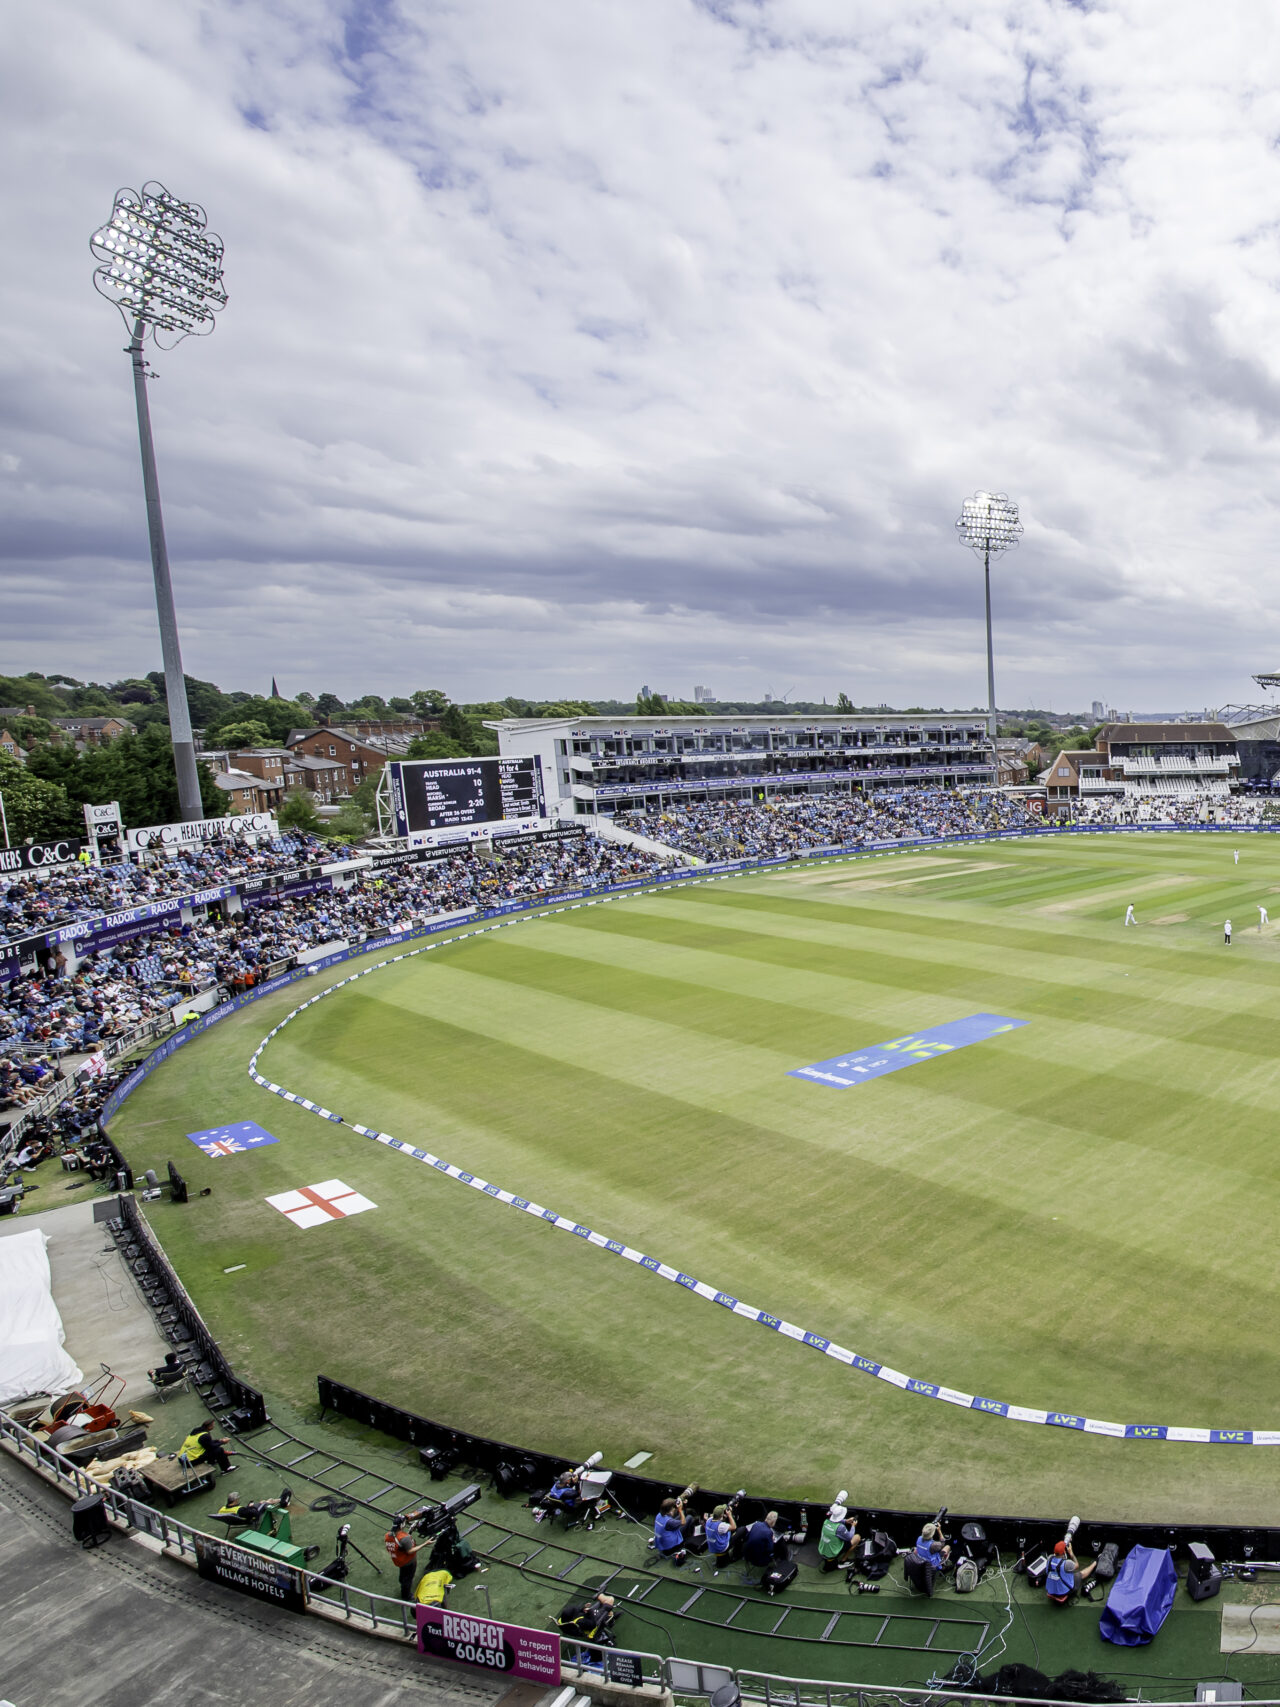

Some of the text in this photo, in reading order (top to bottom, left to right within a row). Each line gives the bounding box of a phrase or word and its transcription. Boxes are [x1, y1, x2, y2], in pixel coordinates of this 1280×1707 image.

[424, 769, 465, 778] AUSTRALIA
[468, 799, 484, 807] 2-20
[1029, 801, 1043, 812] IG
[181, 820, 225, 840] HEALTHCARE
[548, 828, 583, 839] VERTU MOTORS
[500, 834, 537, 845] VERTU MOTORS
[432, 845, 469, 857] VERTU MOTORS
[380, 853, 419, 866] VERTU MOTORS
[194, 890, 222, 904] RADOX
[151, 900, 179, 915] RADOX
[106, 911, 135, 927] RADOX
[59, 923, 90, 941] RADOX
[98, 922, 160, 944] OFFICIAL METAVERSE PARTNER
[220, 1545, 275, 1574] EVERYTHING
[216, 1565, 285, 1599] VILLAGE HOTELS
[427, 1614, 504, 1650] Text RESPECT
[519, 1638, 552, 1652] to report
[447, 1640, 506, 1668] to 60650
[517, 1650, 555, 1664] anti-social
[519, 1660, 555, 1675] behaviour
